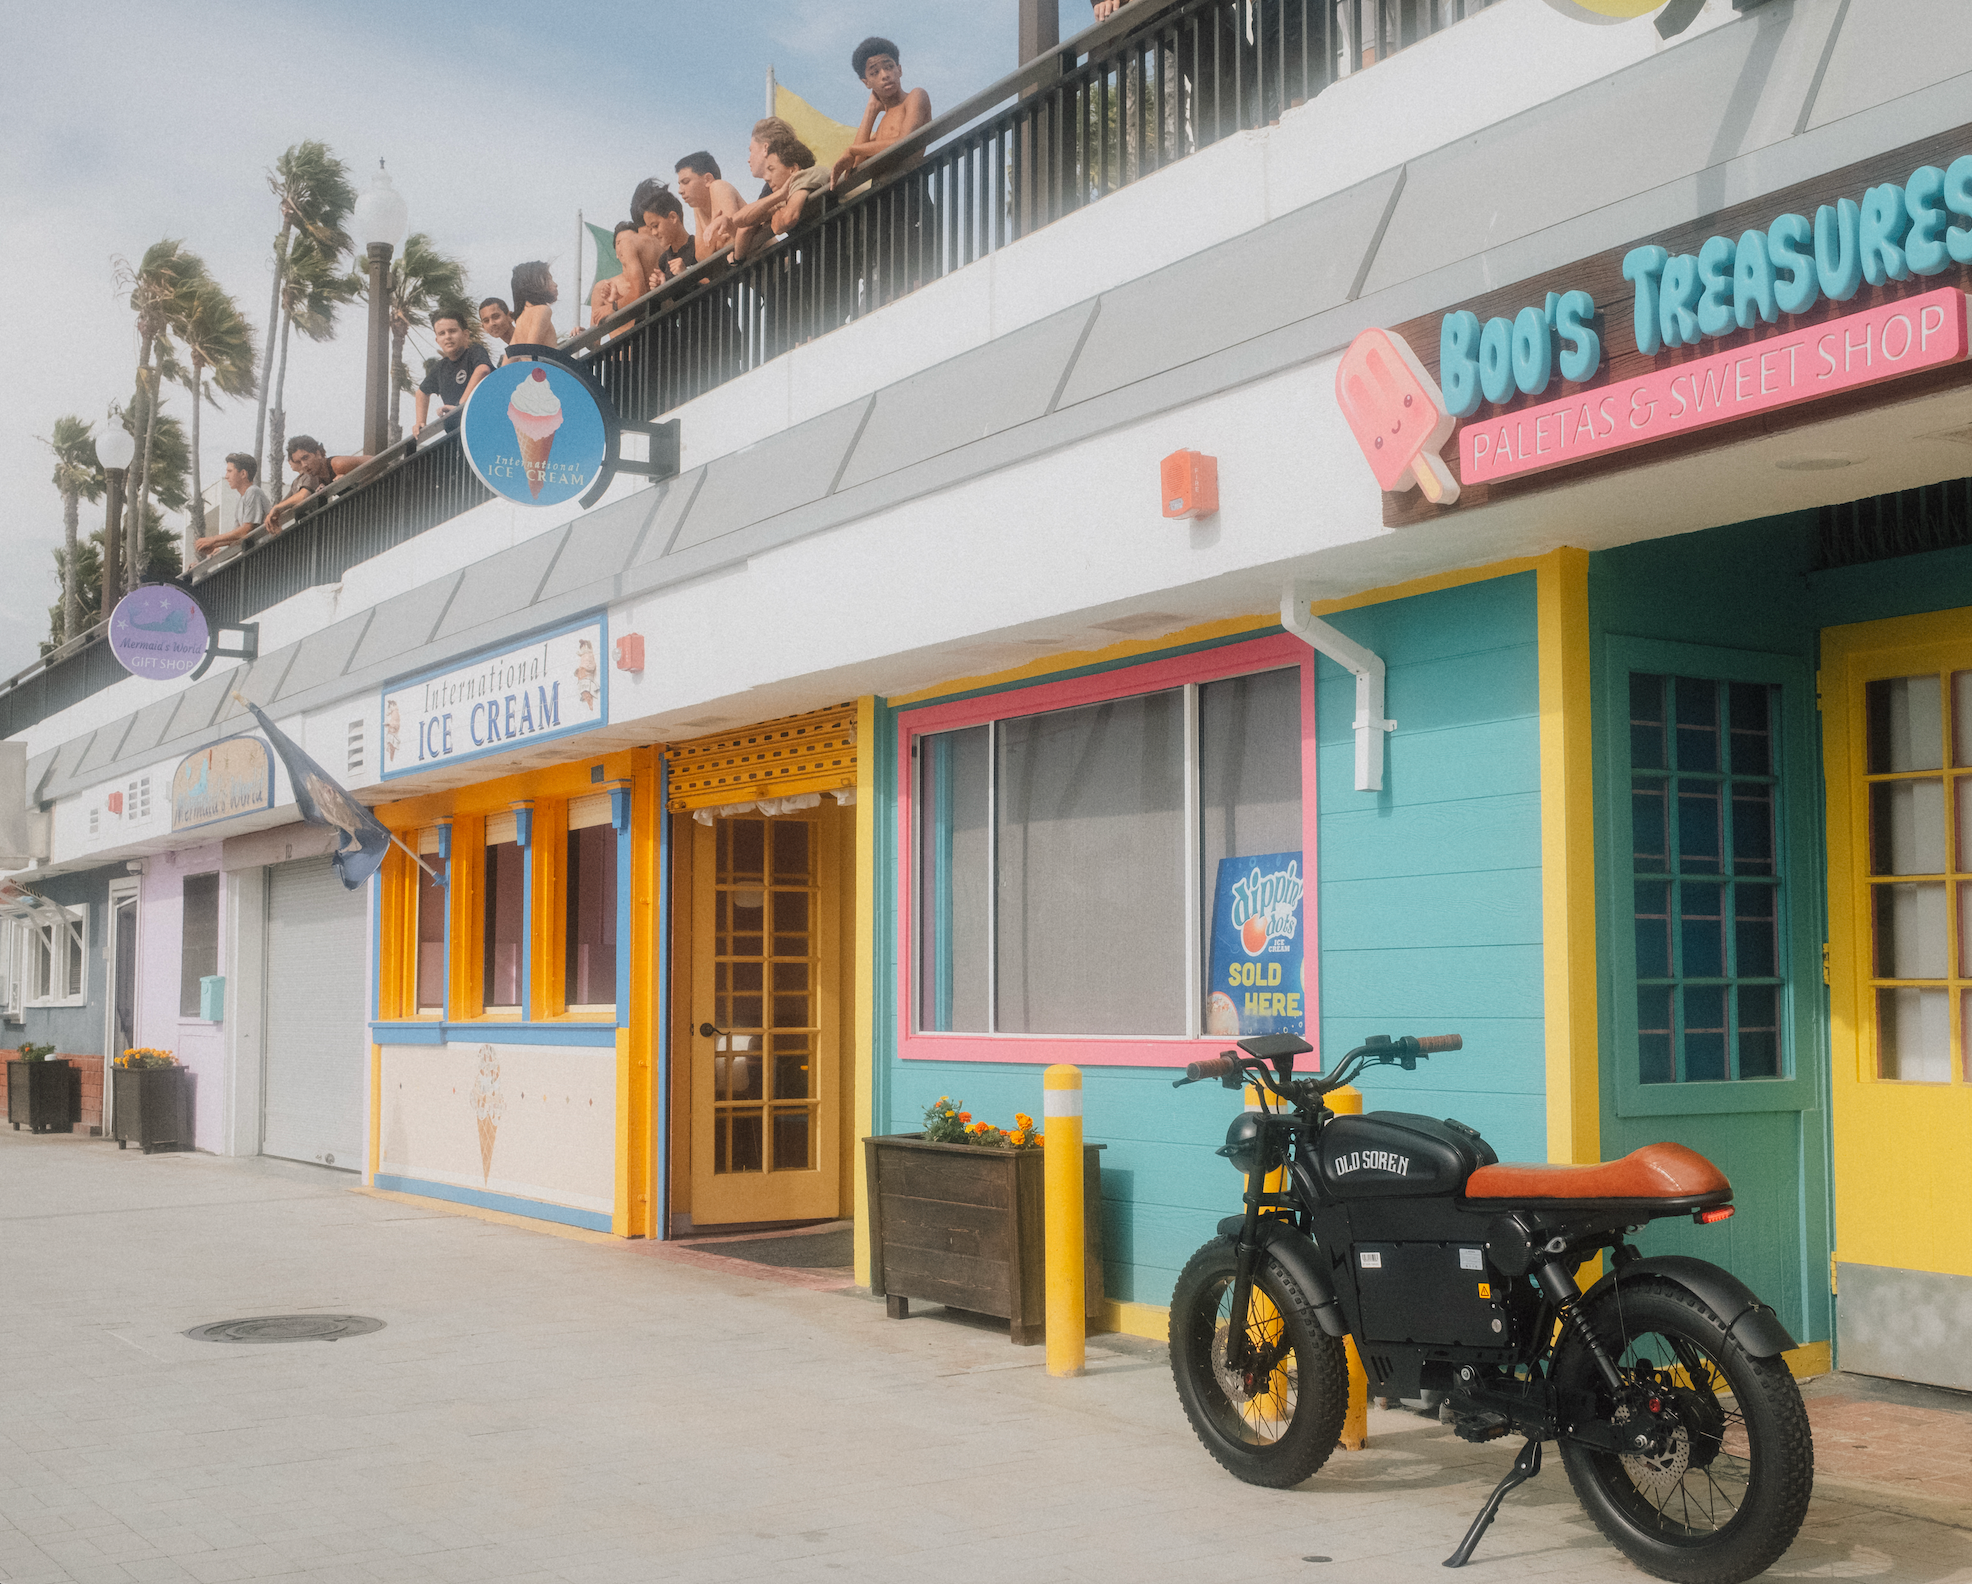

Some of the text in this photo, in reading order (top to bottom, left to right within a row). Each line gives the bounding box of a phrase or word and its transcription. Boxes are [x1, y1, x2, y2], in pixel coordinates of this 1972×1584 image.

[1473, 305, 1945, 471] PALETAS & SWEET SHOP
[488, 465, 584, 486] ICE CREAM
[495, 454, 580, 472] International
[173, 641, 203, 655] World
[131, 656, 194, 671] GIFT SHOP
[424, 642, 549, 713] International
[418, 680, 561, 762] ICE CREAM
[1265, 913, 1296, 938] dots
[1268, 945, 1291, 953] CREAM
[1228, 962, 1282, 987] SOLD
[1244, 992, 1302, 1017] HERE
[1335, 1150, 1410, 1176] OLD SOREN
